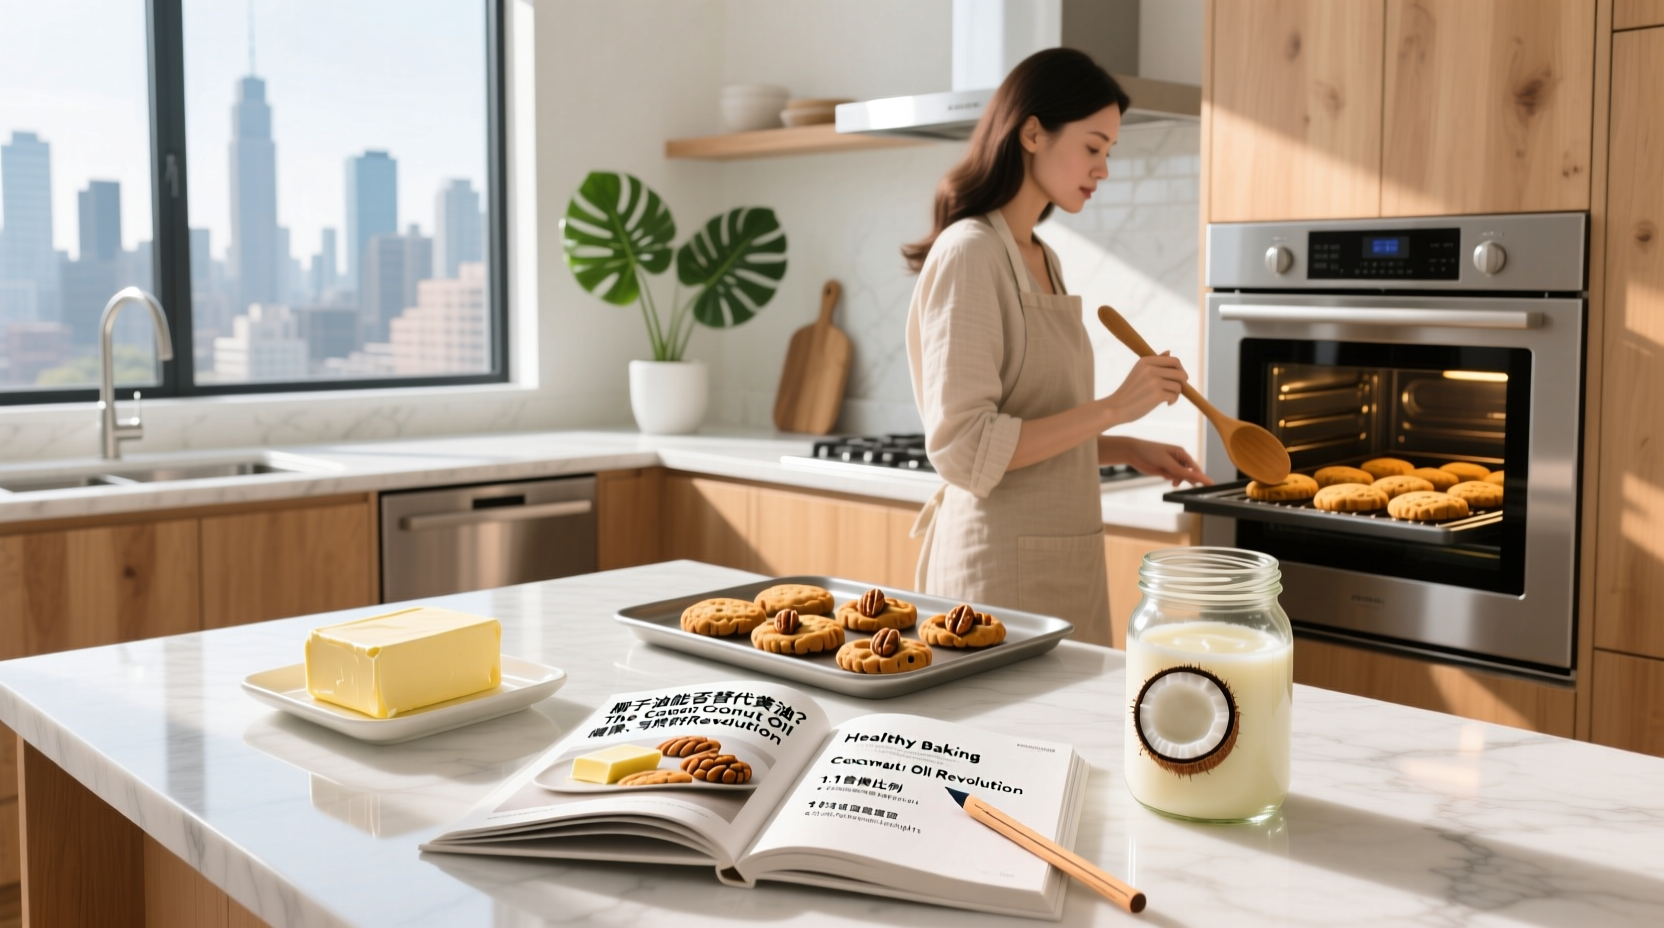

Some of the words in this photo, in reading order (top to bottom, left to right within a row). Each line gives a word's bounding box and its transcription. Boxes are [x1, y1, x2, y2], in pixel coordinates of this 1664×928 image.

[844, 732, 917, 749] Healthy
[921, 740, 981, 764] Baking
[935, 769, 1023, 795] Revolution
